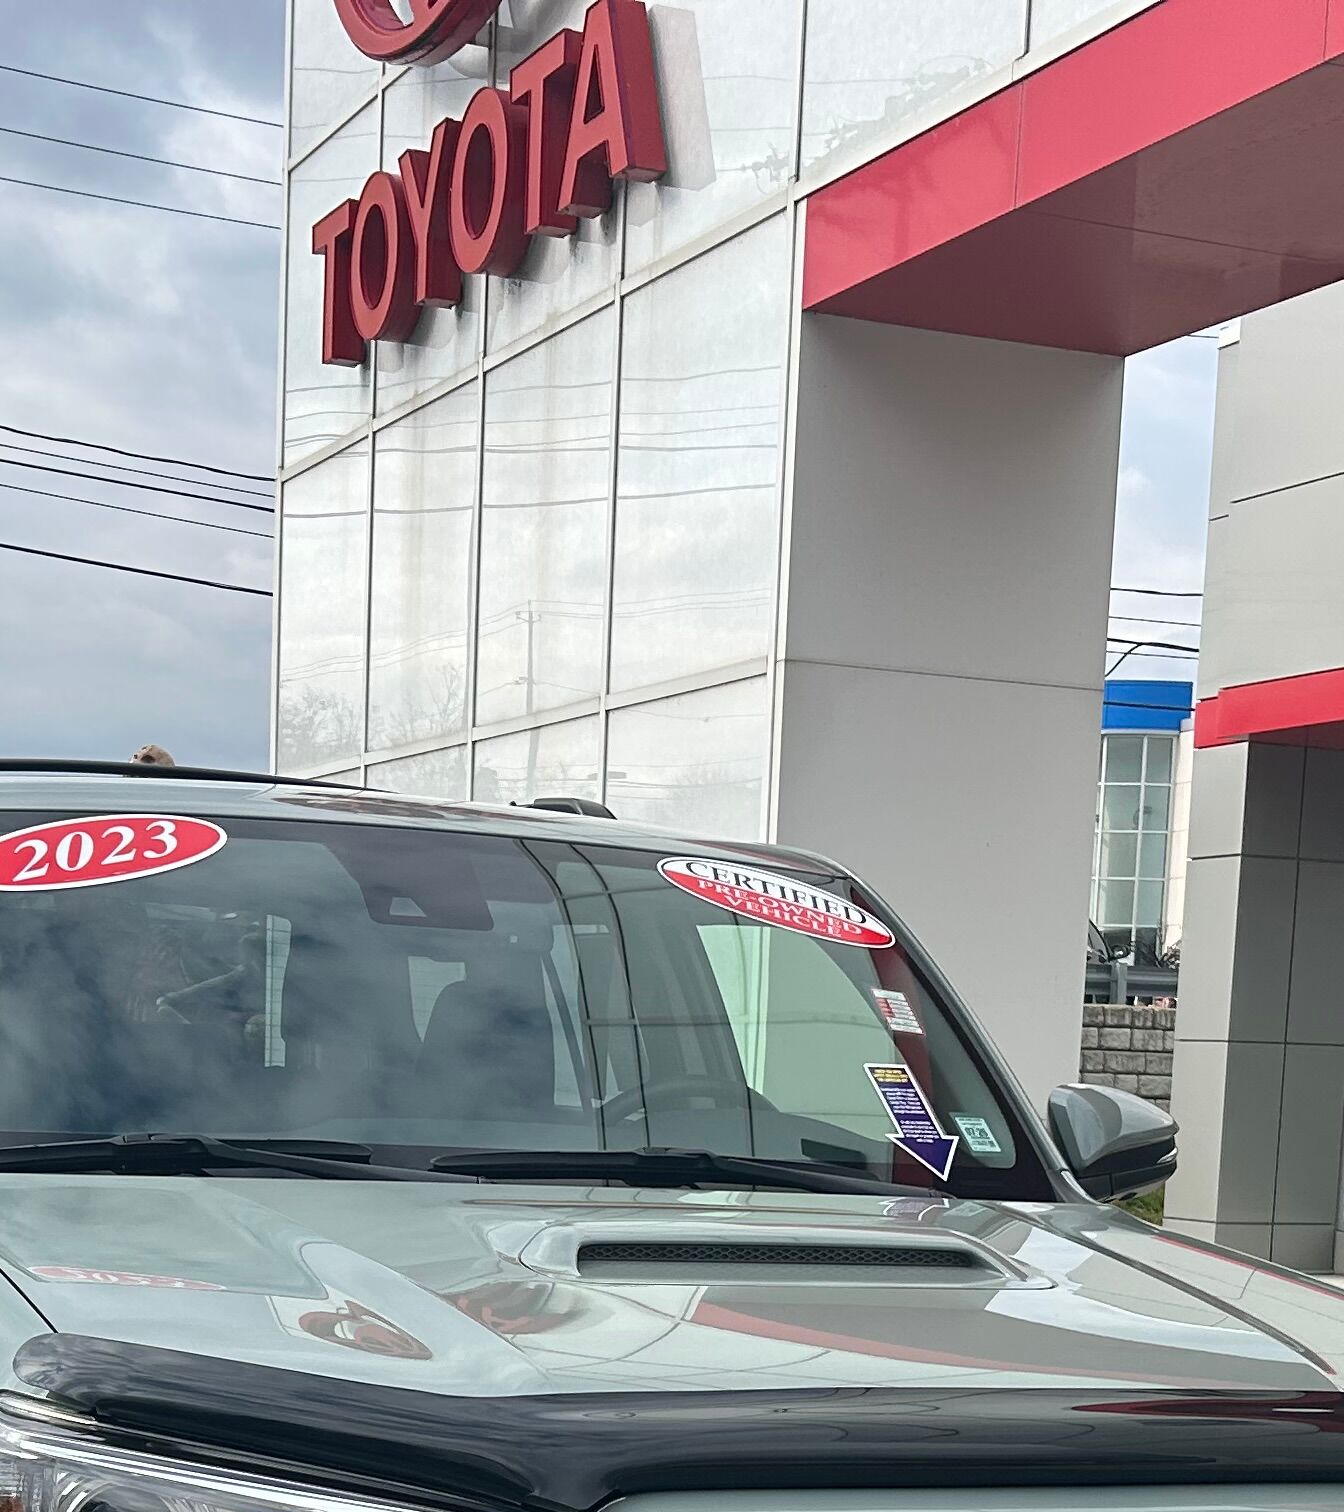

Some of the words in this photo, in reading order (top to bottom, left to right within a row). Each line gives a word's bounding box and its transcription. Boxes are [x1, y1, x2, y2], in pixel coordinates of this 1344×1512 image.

[312, 0, 665, 368] TOYOTA
[12, 820, 178, 882] 2023
[686, 861, 867, 924] CERTIFIED
[697, 879, 862, 935] PRE-OWNED
[723, 895, 843, 938] VEHICLE
